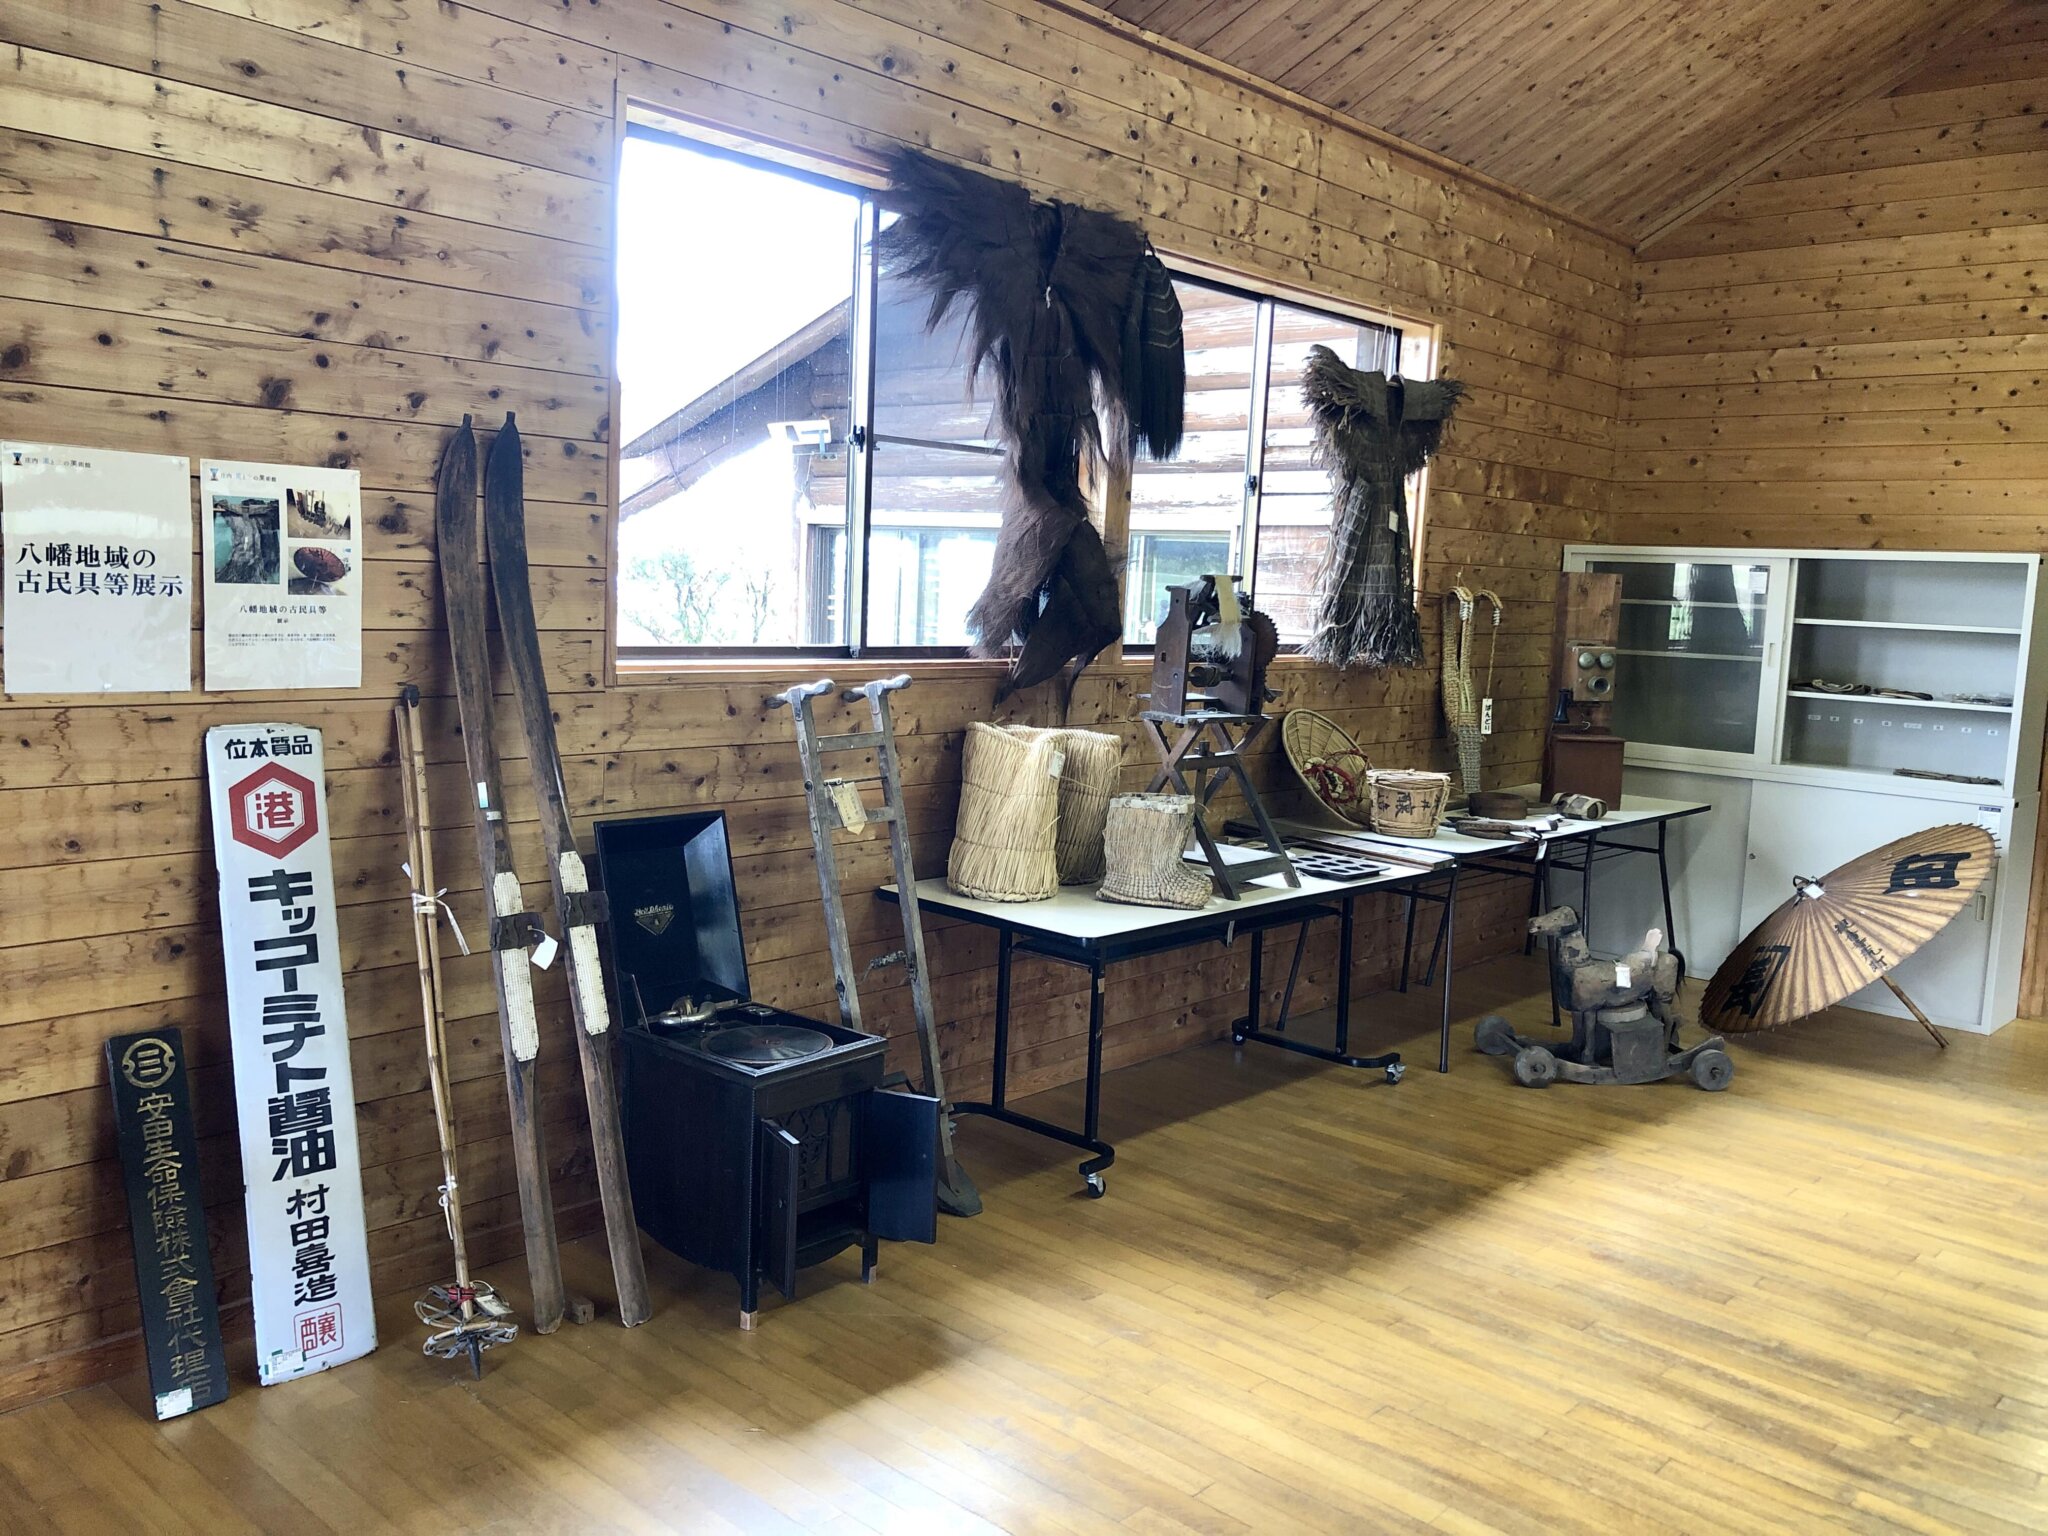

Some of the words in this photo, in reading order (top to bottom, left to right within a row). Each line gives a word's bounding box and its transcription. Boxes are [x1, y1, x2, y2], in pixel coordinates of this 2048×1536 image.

[16, 542, 156, 569] 八幡地域の
[16, 570, 183, 597] 古民具等展示
[239, 605, 327, 614] 八幡地域の古民具等
[254, 792, 296, 831] 港
[285, 1183, 338, 1307] 村田喜造
